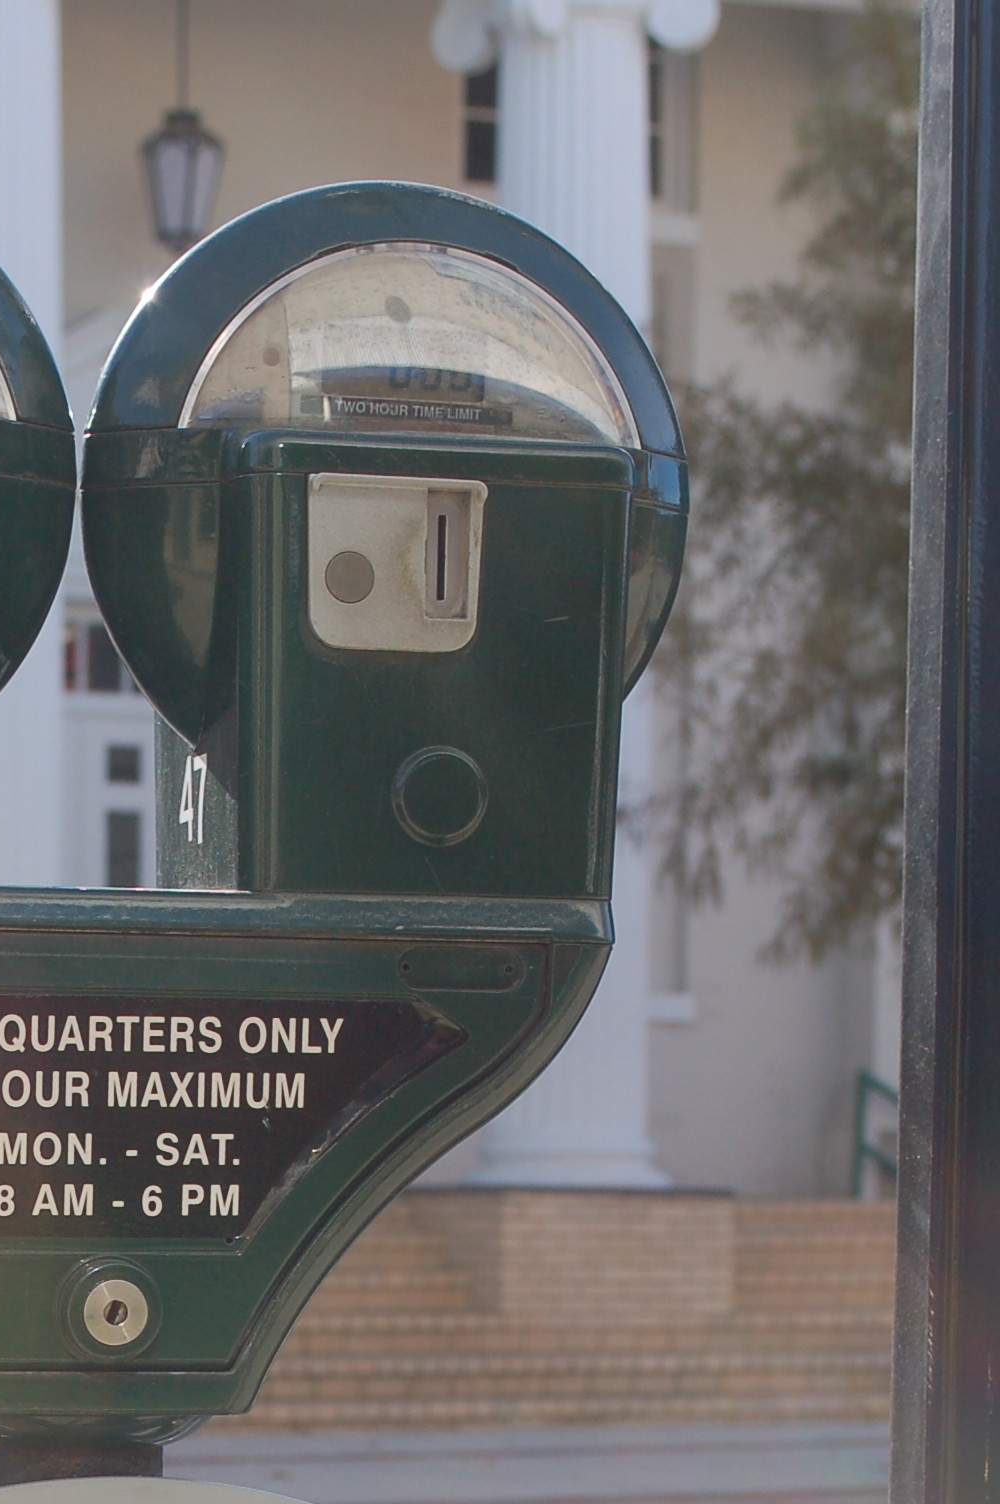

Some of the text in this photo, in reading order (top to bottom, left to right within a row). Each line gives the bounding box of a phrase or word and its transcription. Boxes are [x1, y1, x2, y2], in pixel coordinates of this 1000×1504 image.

[334, 399, 482, 421] TWO HOUR TIME LIMIT
[179, 753, 208, 844] 47
[238, 1016, 345, 1055] ONLY
[106, 1071, 306, 1110] MAXIMUM
[155, 1132, 242, 1167] SAT.
[31, 1184, 95, 1217] AM
[140, 1184, 164, 1218] 6
[180, 1184, 241, 1218] PM
